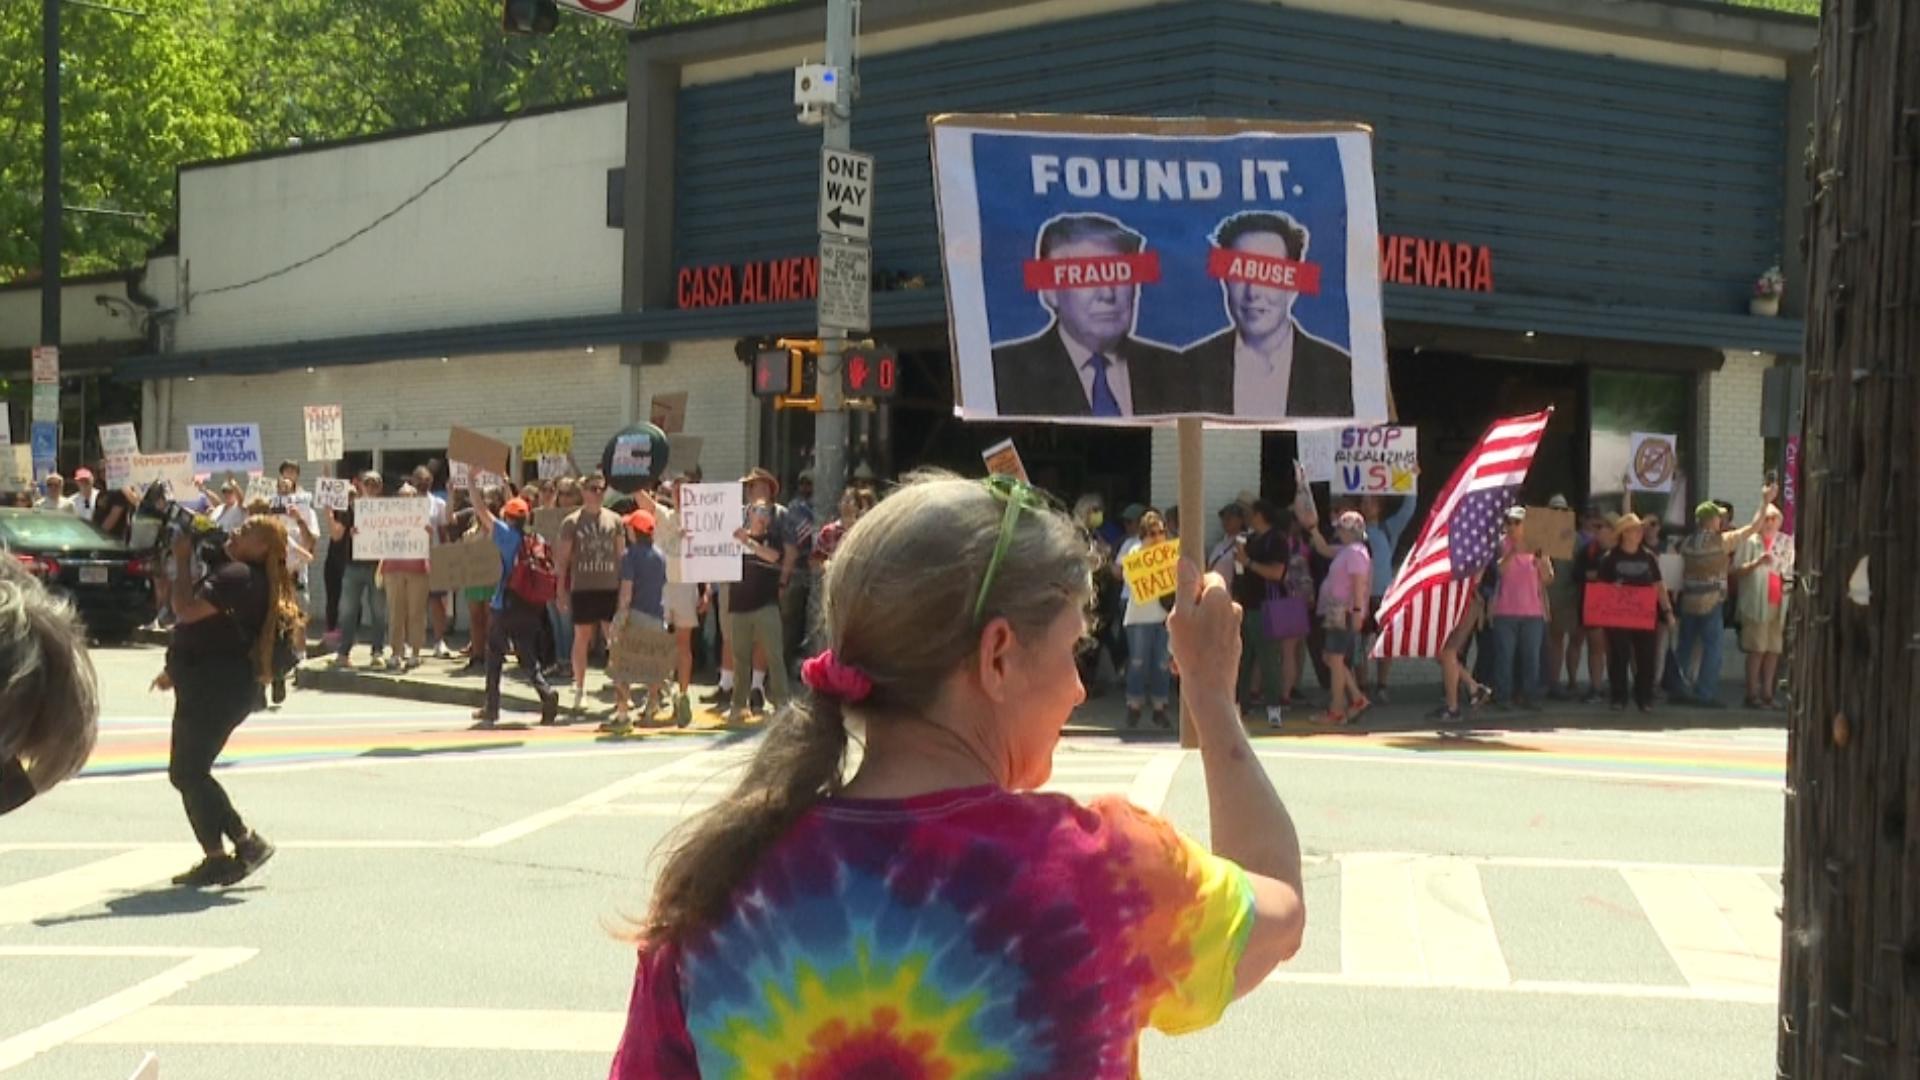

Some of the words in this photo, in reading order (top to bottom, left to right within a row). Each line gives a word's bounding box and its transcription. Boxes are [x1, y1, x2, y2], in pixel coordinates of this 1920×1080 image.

[827, 156, 868, 182] ONE
[1031, 154, 1222, 199] FOUND
[1241, 159, 1303, 200] IT.
[827, 181, 867, 207] WAY
[1054, 262, 1132, 286] FRAUD
[1229, 256, 1297, 286] ABUSE
[1377, 235, 1495, 293] MENARA
[678, 264, 734, 310] CASA
[740, 256, 821, 304] ALMEN
[880, 359, 893, 390] 0
[194, 427, 250, 439] IMPEACH
[202, 439, 244, 451] INDICT
[1341, 426, 1402, 449] STOP
[196, 450, 258, 464] IMPRISON
[683, 487, 726, 507] DEPORT
[684, 511, 726, 532] ELON
[1143, 545, 1169, 567] GOP
